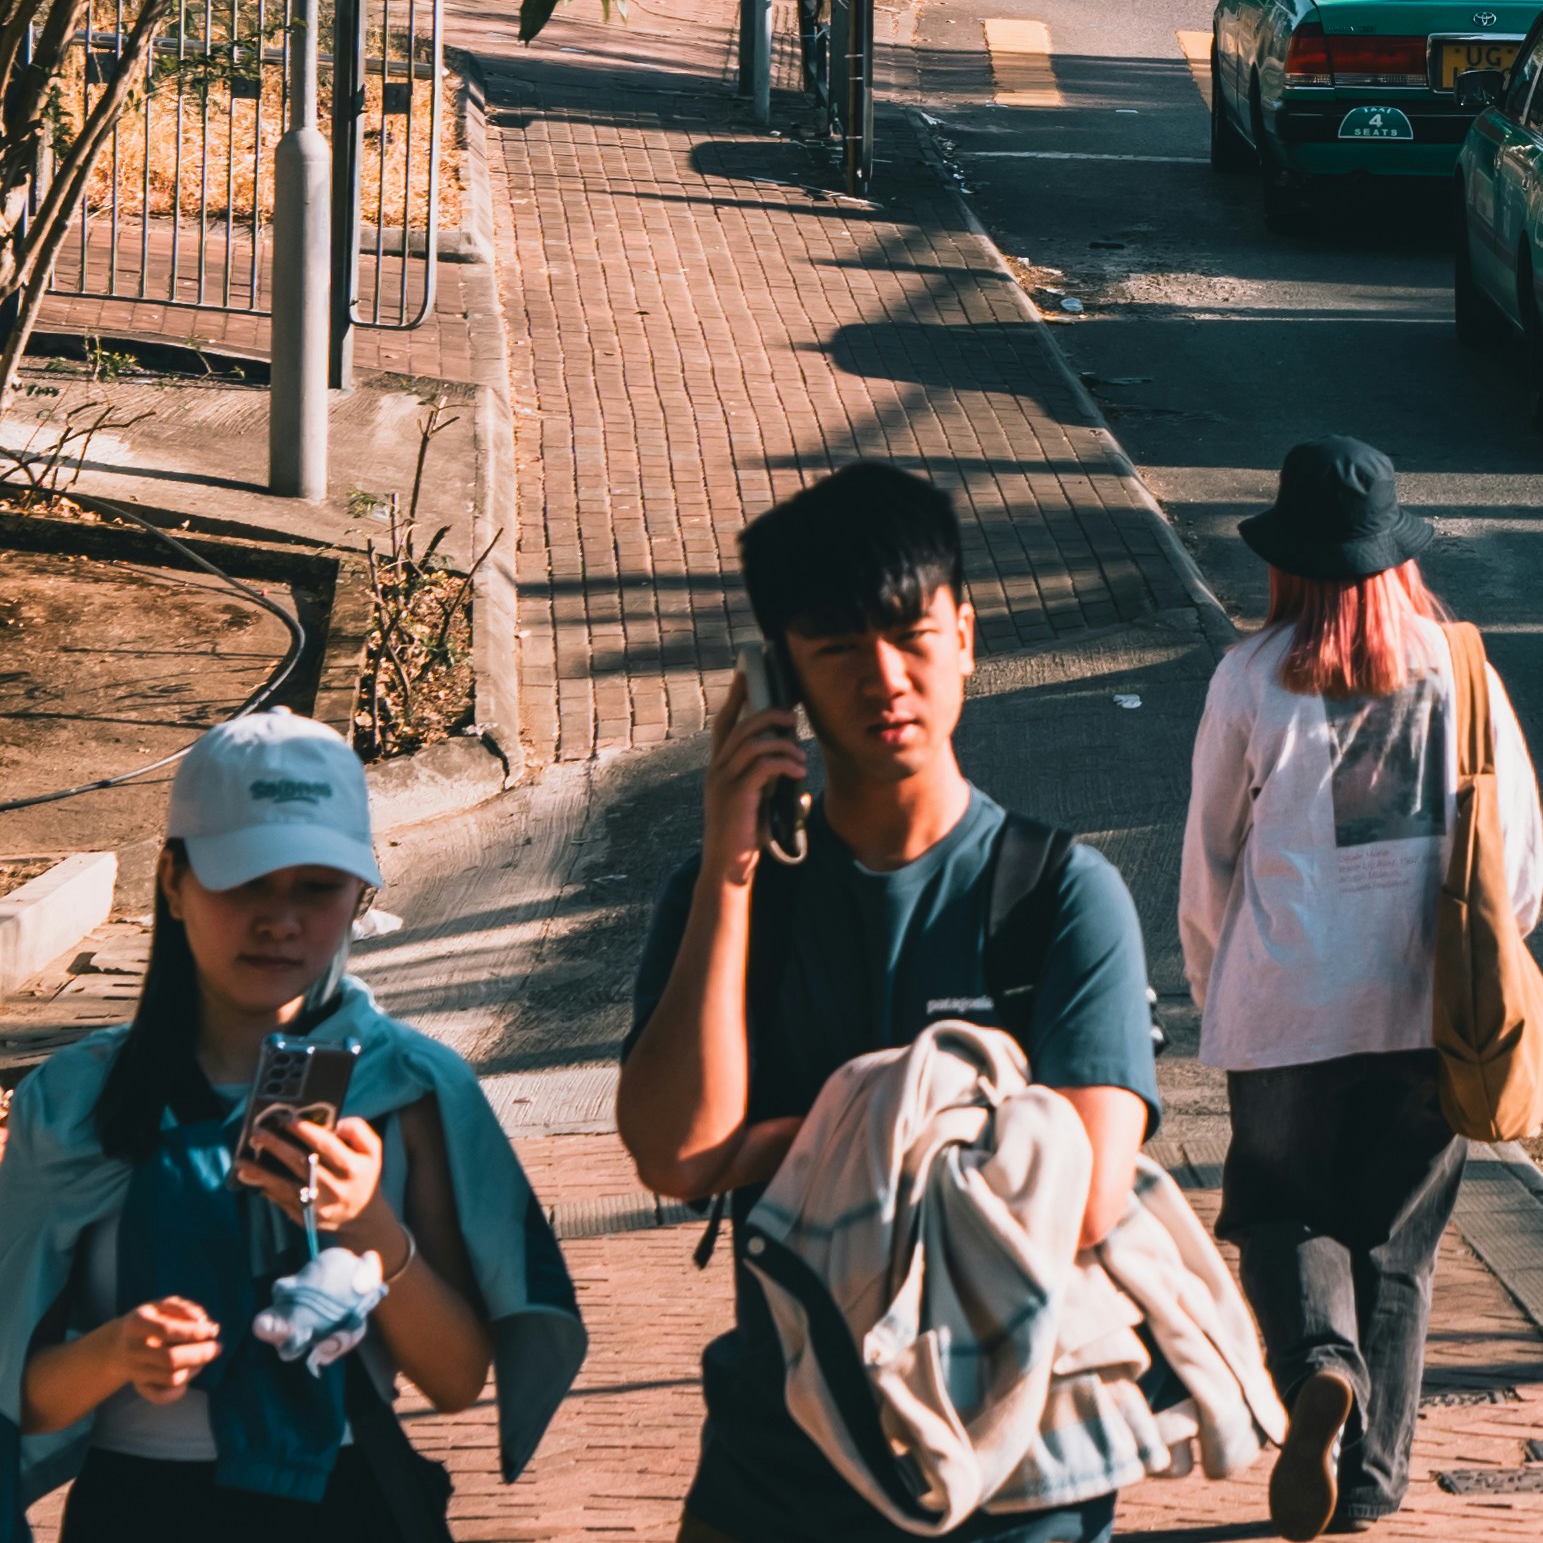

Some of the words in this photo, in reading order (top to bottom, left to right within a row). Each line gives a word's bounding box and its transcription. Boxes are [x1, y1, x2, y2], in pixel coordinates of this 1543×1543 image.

[1466, 46, 1502, 67] UG
[1368, 113, 1384, 128] 4
[1354, 128, 1398, 137] SEATS
